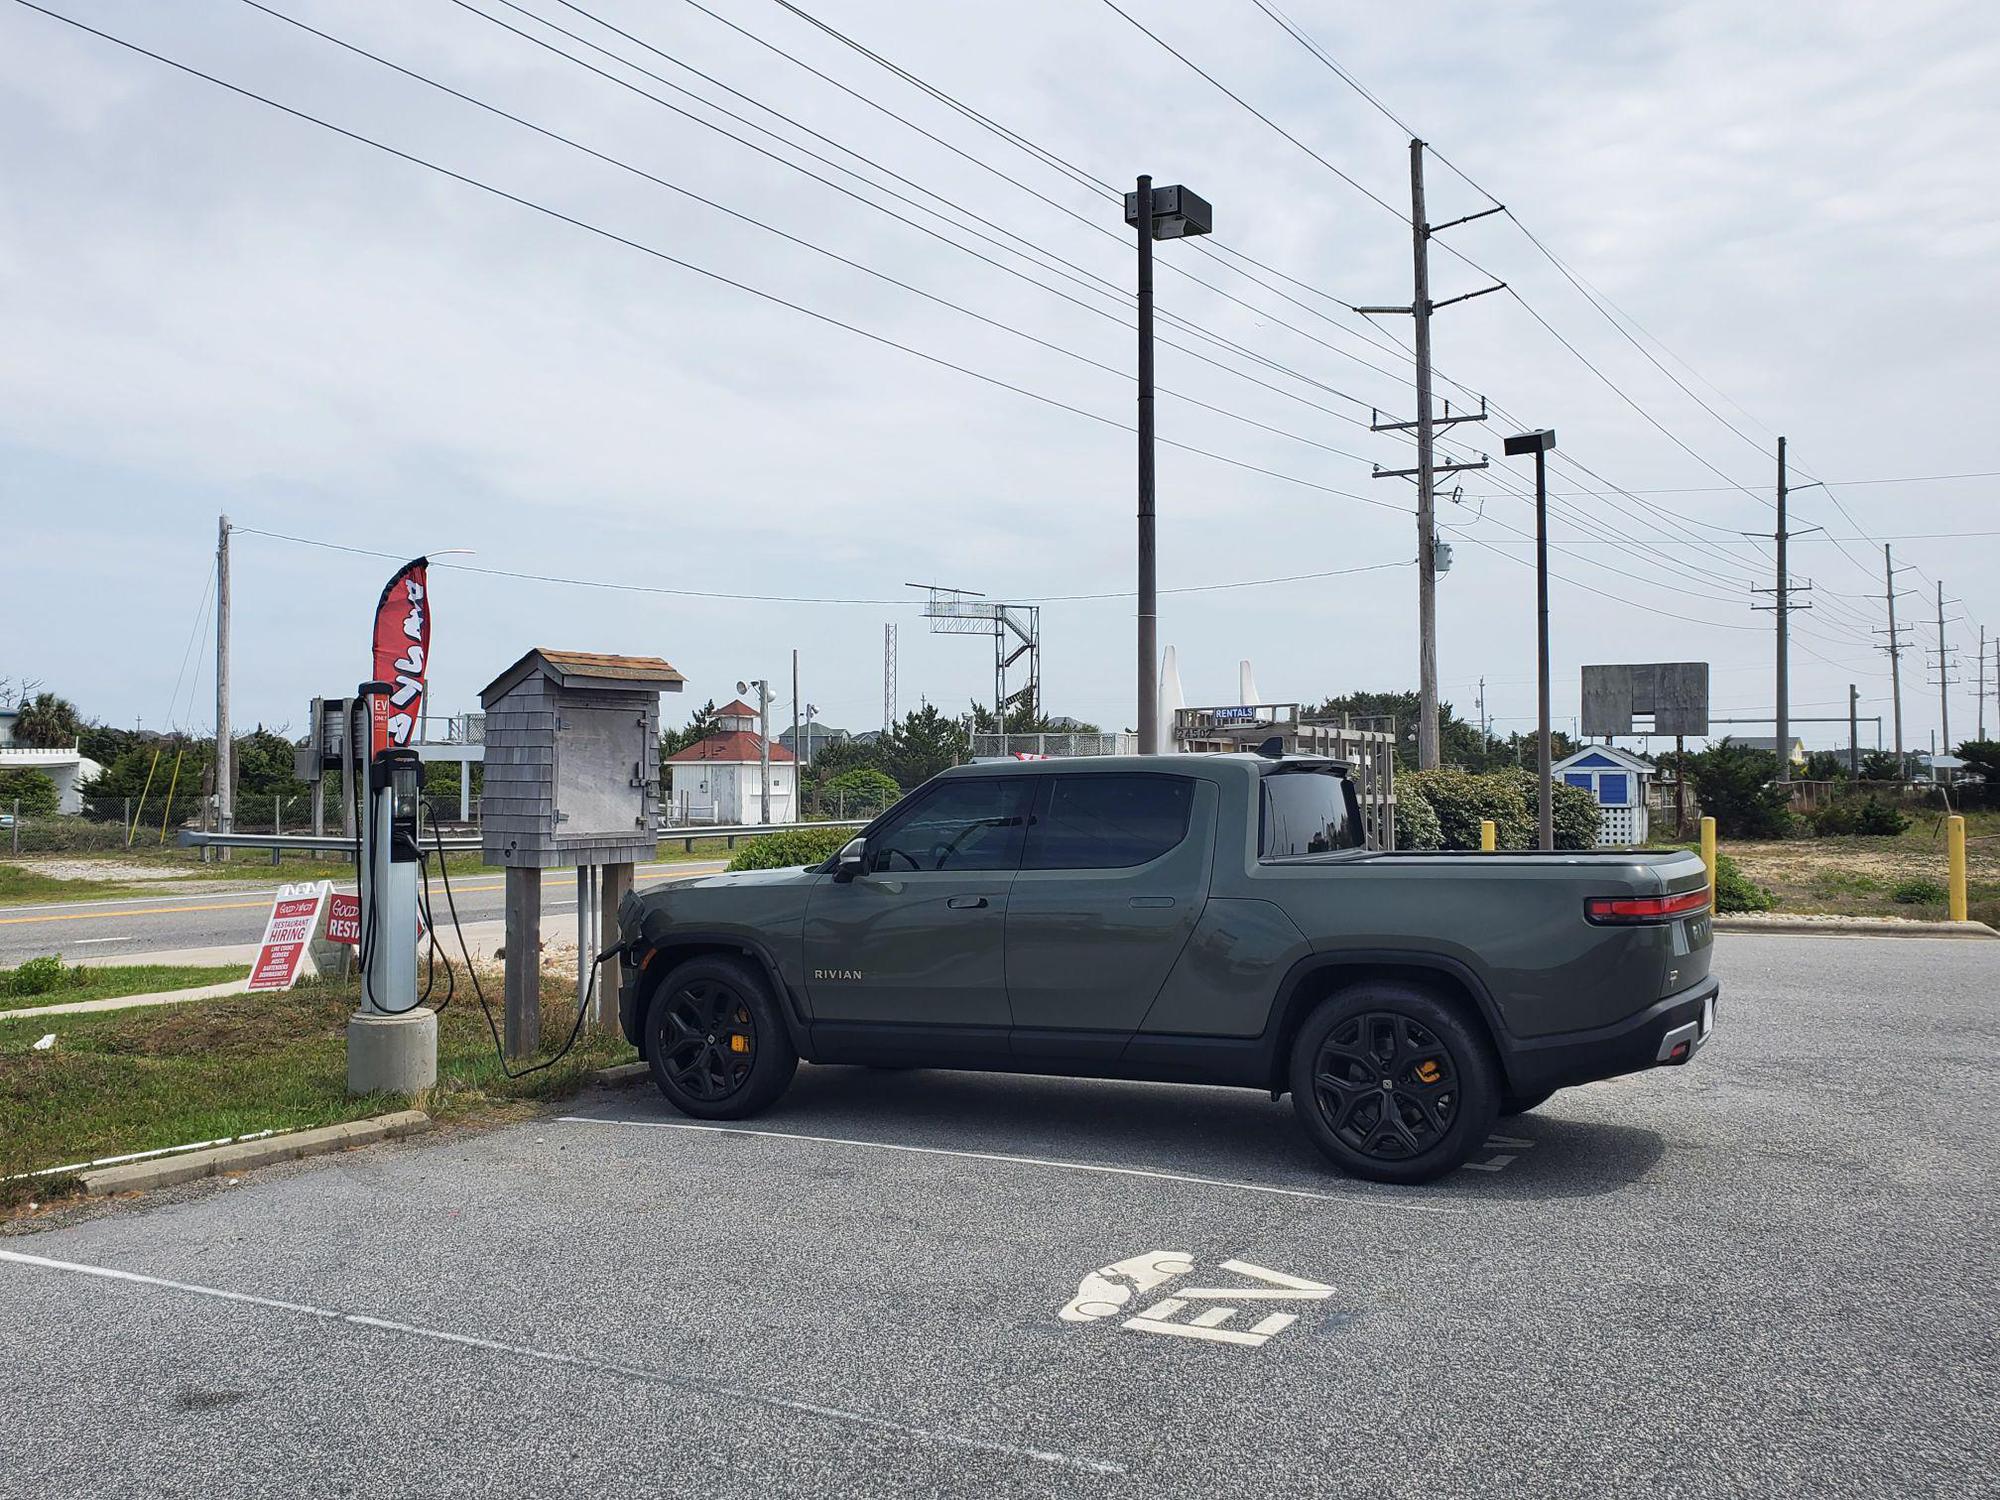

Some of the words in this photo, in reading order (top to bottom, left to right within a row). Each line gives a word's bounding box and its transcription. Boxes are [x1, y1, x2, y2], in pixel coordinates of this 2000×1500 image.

[375, 700, 387, 711] EV
[1216, 708, 1253, 717] RENTALS
[1176, 729, 1212, 739] 24502
[273, 919, 309, 928] RESTAURANT
[269, 927, 306, 942] HIRING
[814, 969, 862, 979] RIVIAN
[1121, 1258, 1337, 1347] EV
